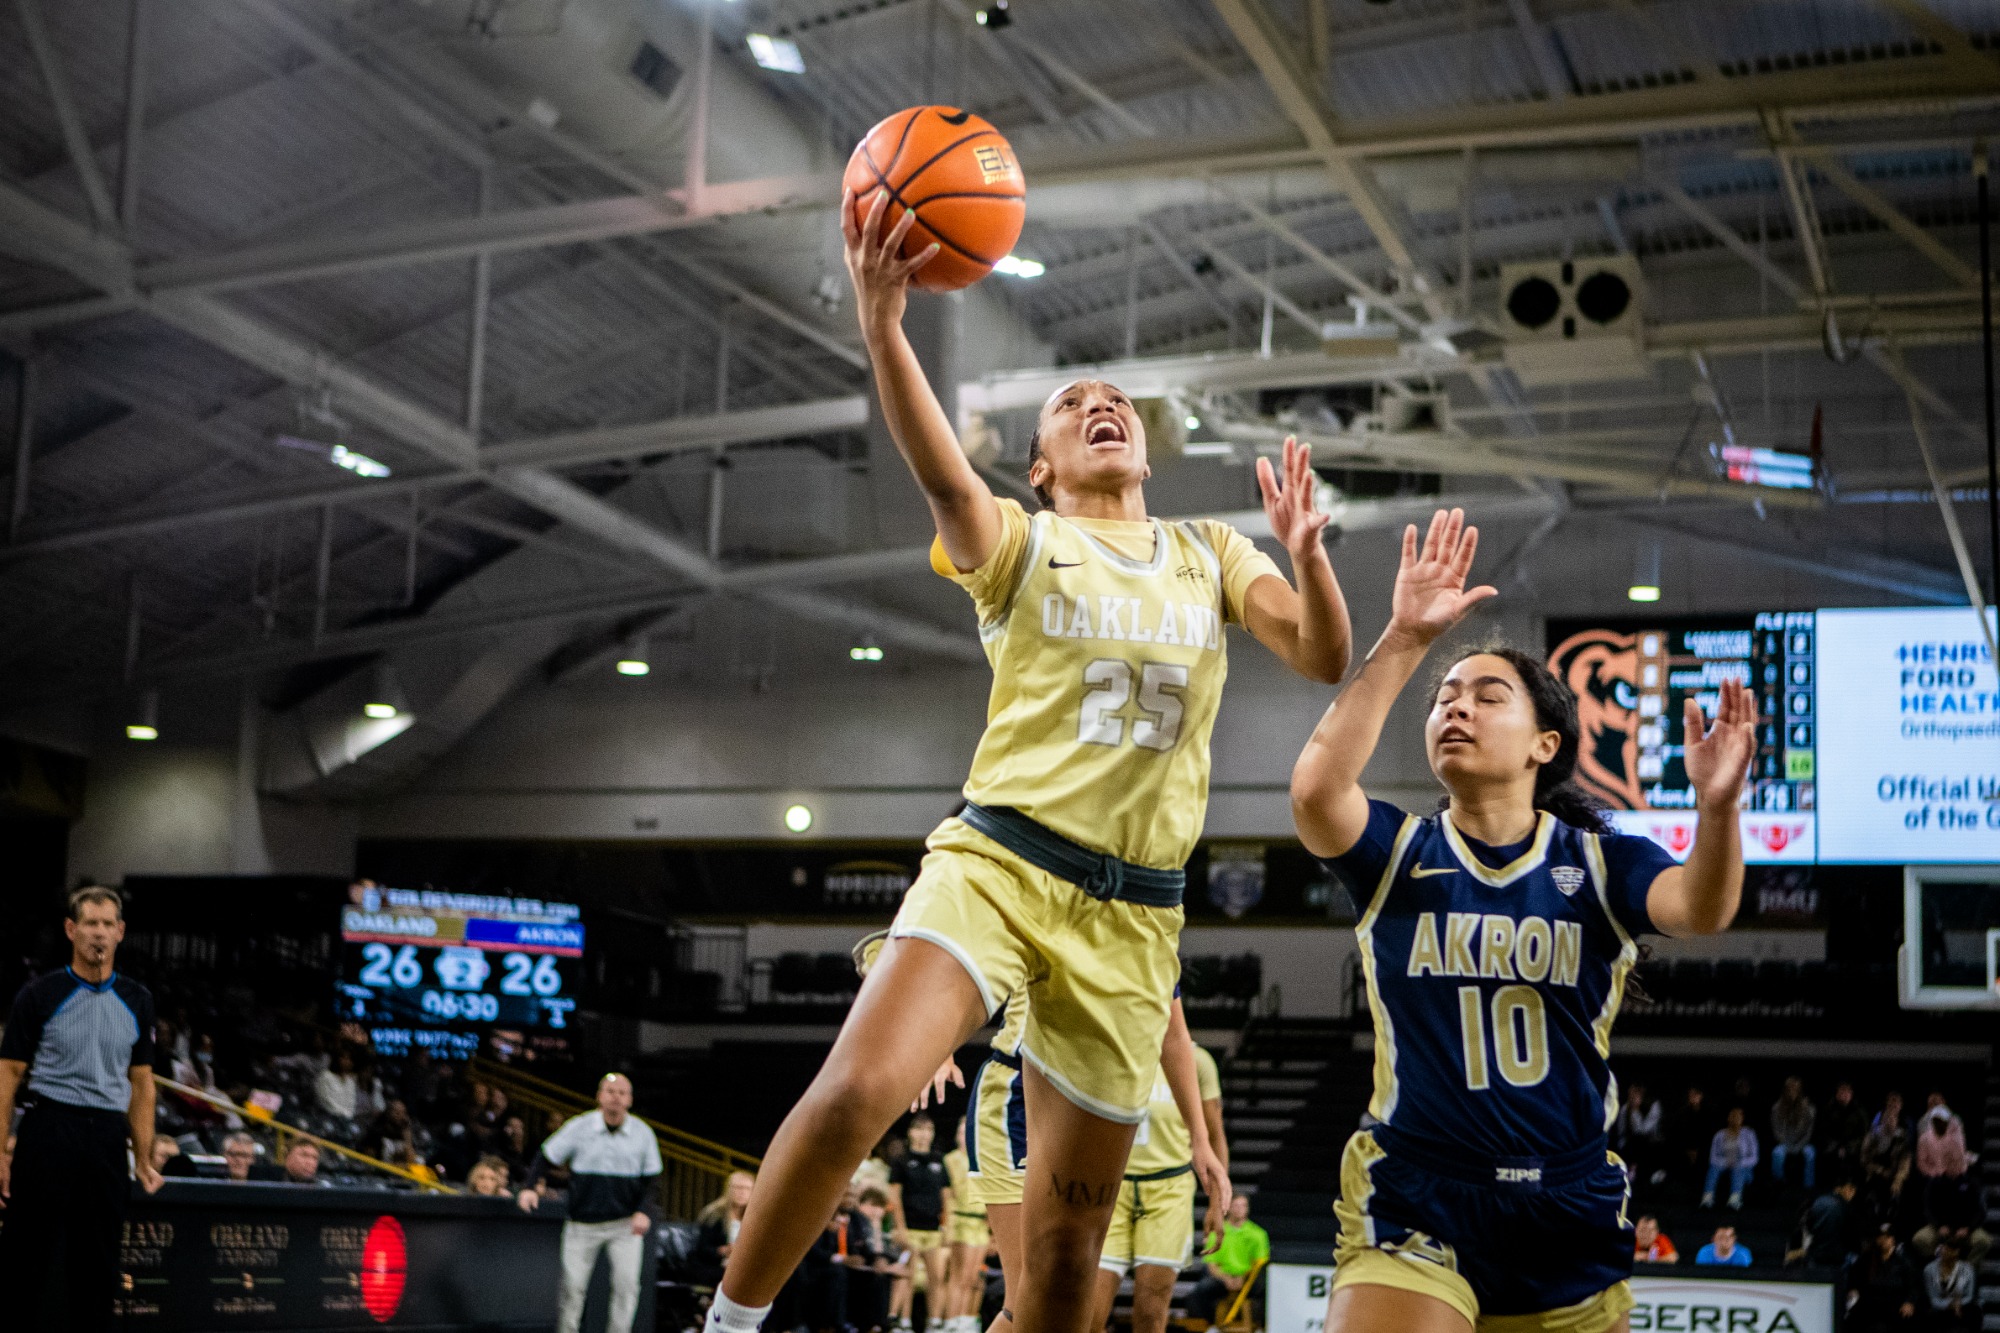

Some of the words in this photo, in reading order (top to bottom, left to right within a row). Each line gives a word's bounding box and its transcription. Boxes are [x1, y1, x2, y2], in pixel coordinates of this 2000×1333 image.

[1041, 593, 1220, 651] OAKLAND
[1900, 669, 1975, 688] FORD
[1077, 658, 1188, 753] 25
[1877, 775, 1969, 801] Official
[1904, 805, 1930, 829] of
[1939, 806, 1979, 828] the
[359, 943, 422, 988] 26
[1407, 912, 1582, 988] AKRON
[500, 952, 561, 996] 26
[1458, 985, 1549, 1090] 10
[1496, 1168, 1542, 1182] ZIPS
[1630, 1303, 1806, 1333] SERRA
